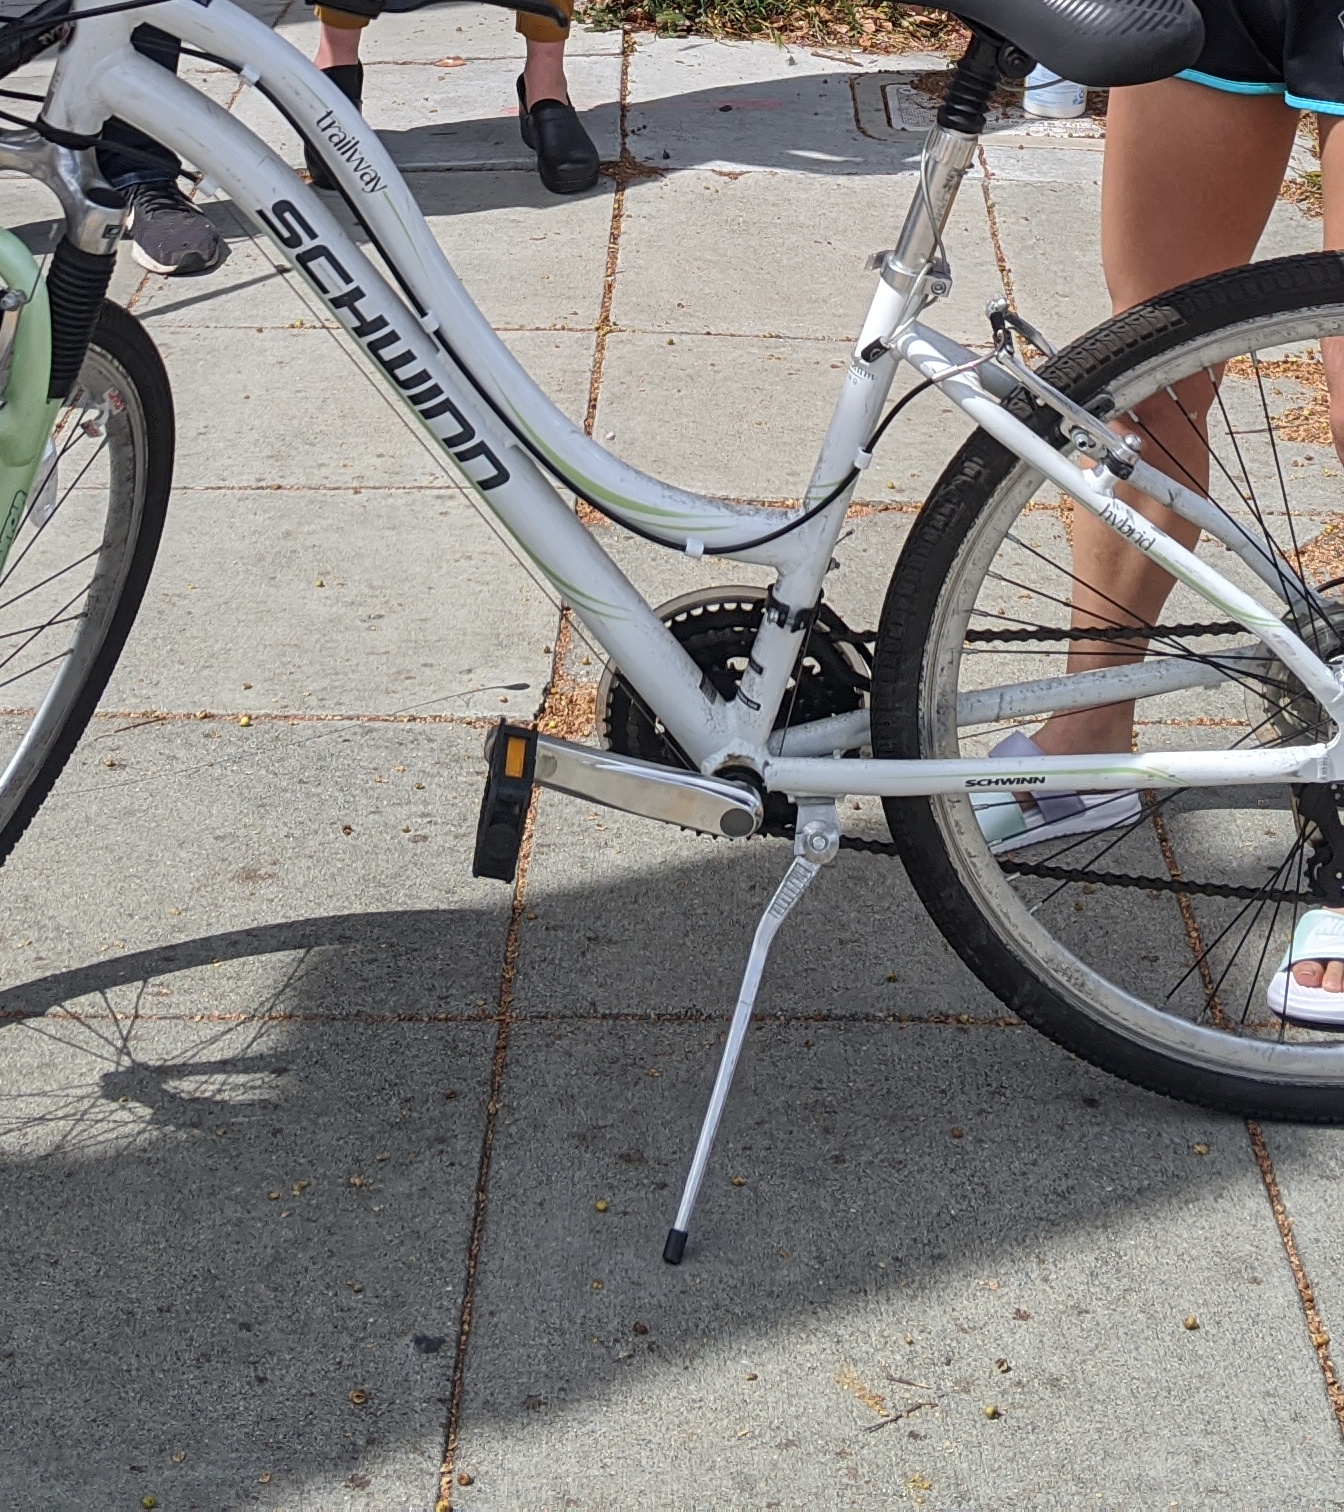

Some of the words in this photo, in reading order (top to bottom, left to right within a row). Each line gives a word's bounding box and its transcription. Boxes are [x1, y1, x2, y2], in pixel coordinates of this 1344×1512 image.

[315, 109, 389, 193] trailway
[256, 199, 511, 491] SCHWINN
[1099, 503, 1157, 552] hybrid
[964, 776, 1046, 788] SCHWINN
